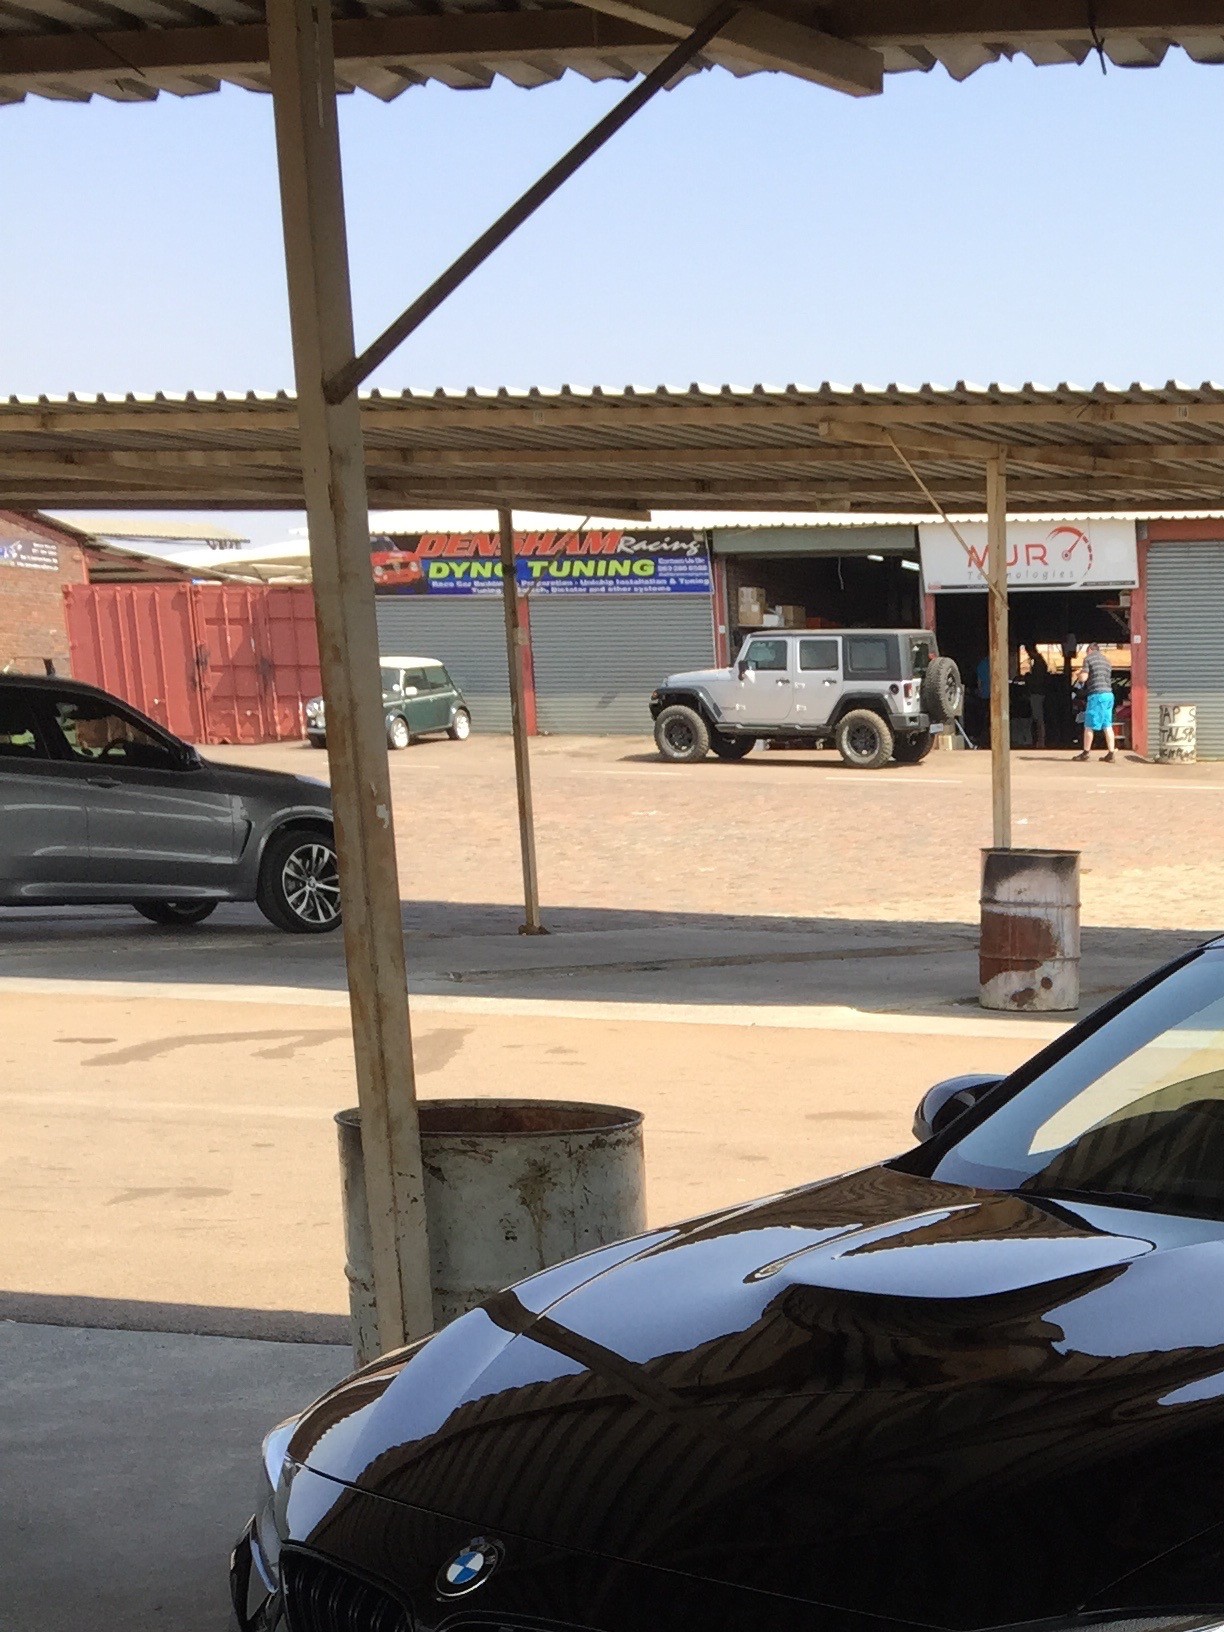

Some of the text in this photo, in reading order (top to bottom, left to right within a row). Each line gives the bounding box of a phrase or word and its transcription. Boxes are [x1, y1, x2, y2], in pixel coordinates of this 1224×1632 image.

[617, 536, 700, 556] Racing
[528, 559, 655, 577] TUNING
[968, 570, 1075, 580] Tenologies
